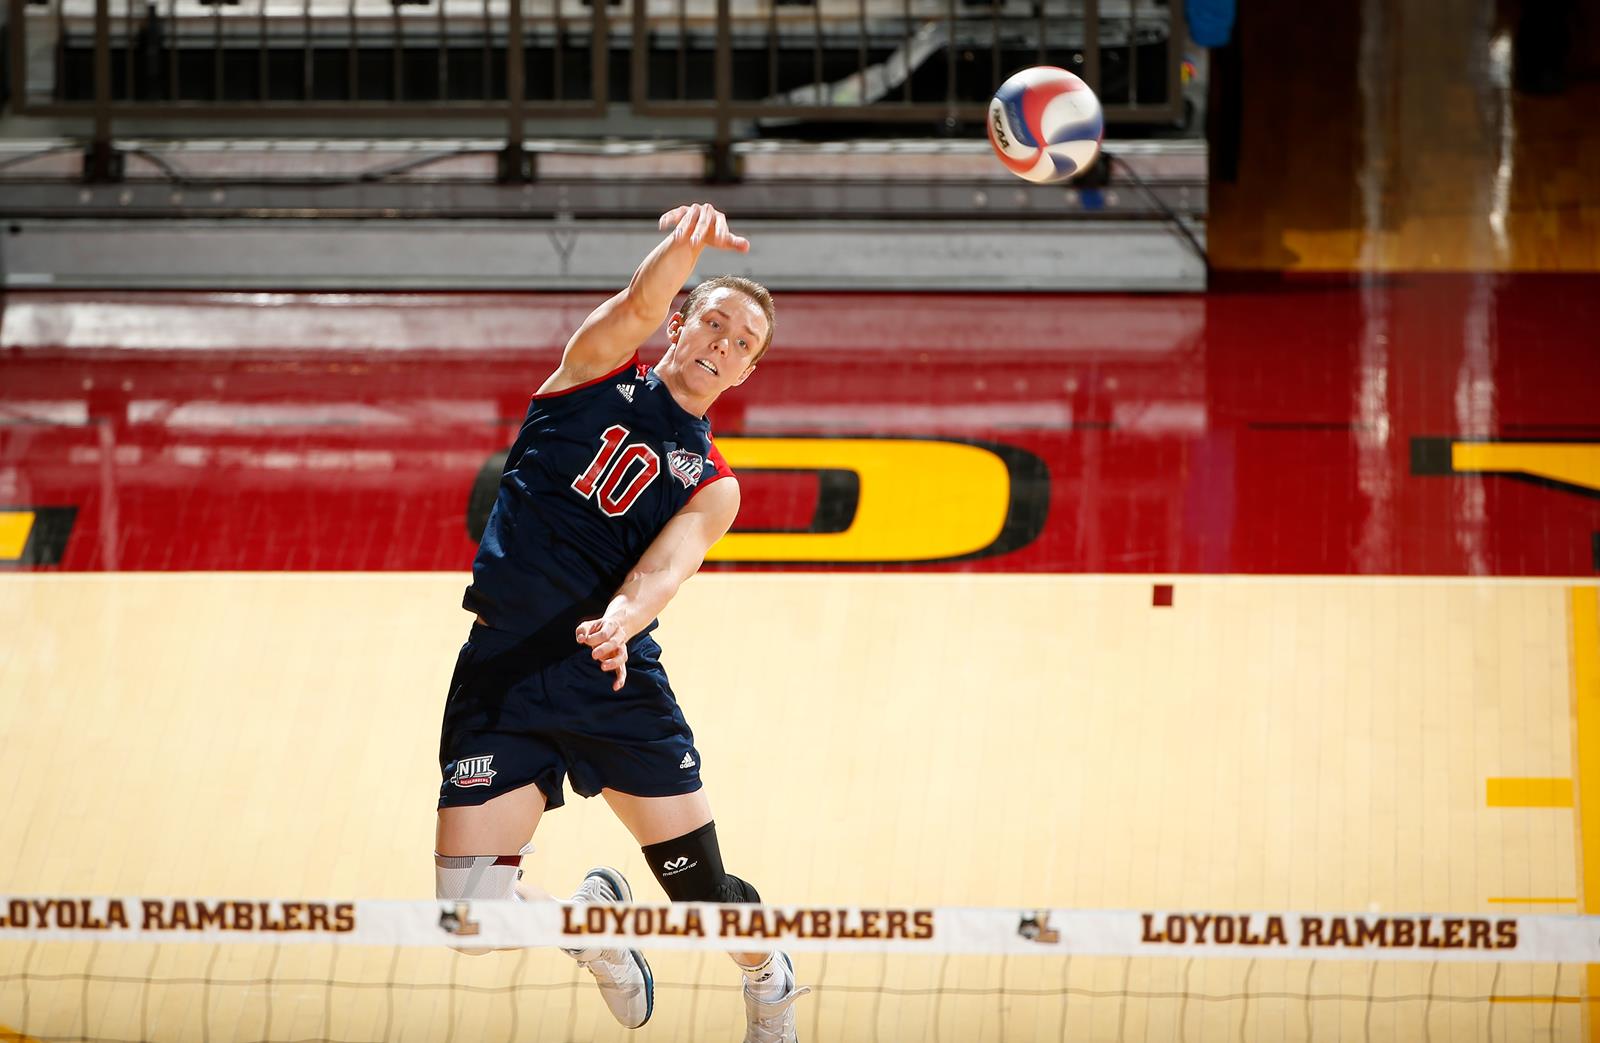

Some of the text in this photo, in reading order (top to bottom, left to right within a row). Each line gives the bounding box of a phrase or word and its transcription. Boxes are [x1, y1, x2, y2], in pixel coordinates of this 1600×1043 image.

[571, 424, 661, 517] 10
[459, 758, 490, 778] NJIT
[141, 900, 355, 932] RAMBLERS
[562, 906, 934, 940] LOYOLA RAMBLERS
[1141, 914, 1518, 949] LOYOLA RAMBLERS
